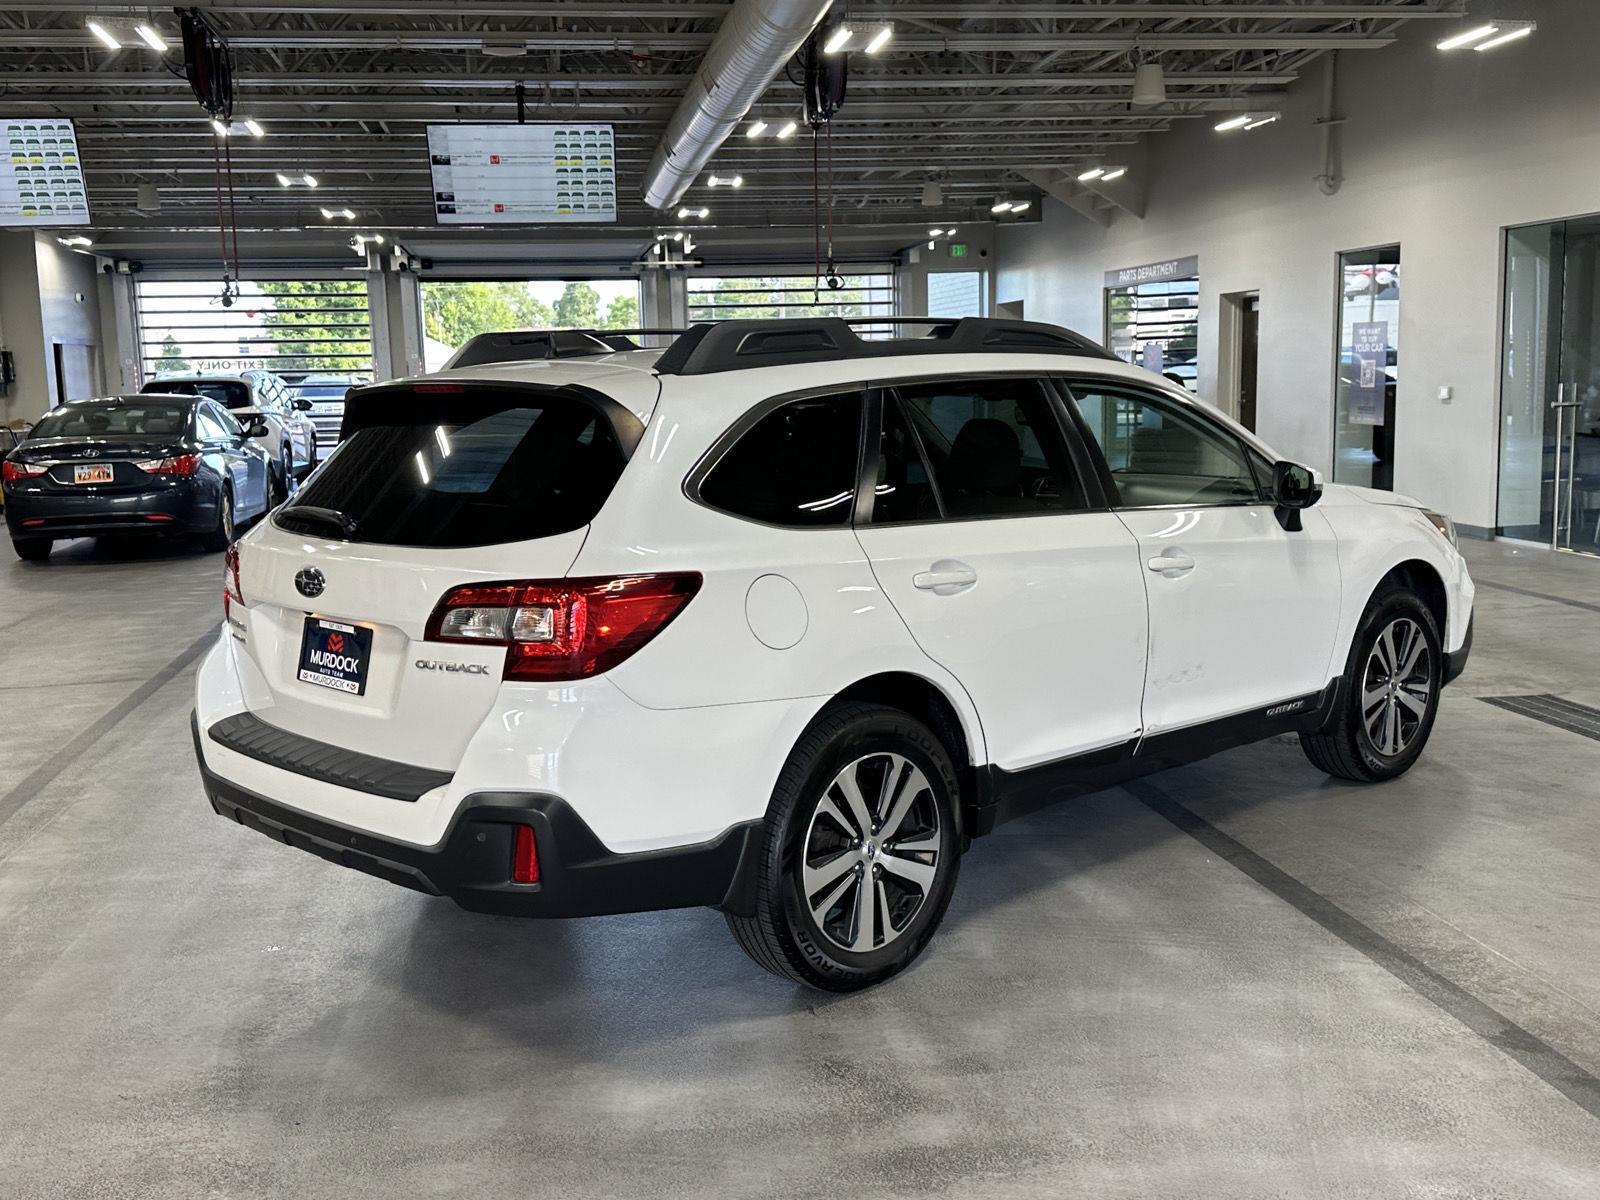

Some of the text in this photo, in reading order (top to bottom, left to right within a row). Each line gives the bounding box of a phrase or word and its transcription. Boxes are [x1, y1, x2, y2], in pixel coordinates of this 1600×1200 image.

[1119, 262, 1178, 283] PARTS DEPARTMENT
[1354, 343, 1385, 353] YOUR CAR
[310, 649, 359, 674] MURDOCK
[415, 660, 491, 675] OUTBACK
[313, 674, 345, 688] MURDOCK
[332, 670, 344, 678] TEAM
